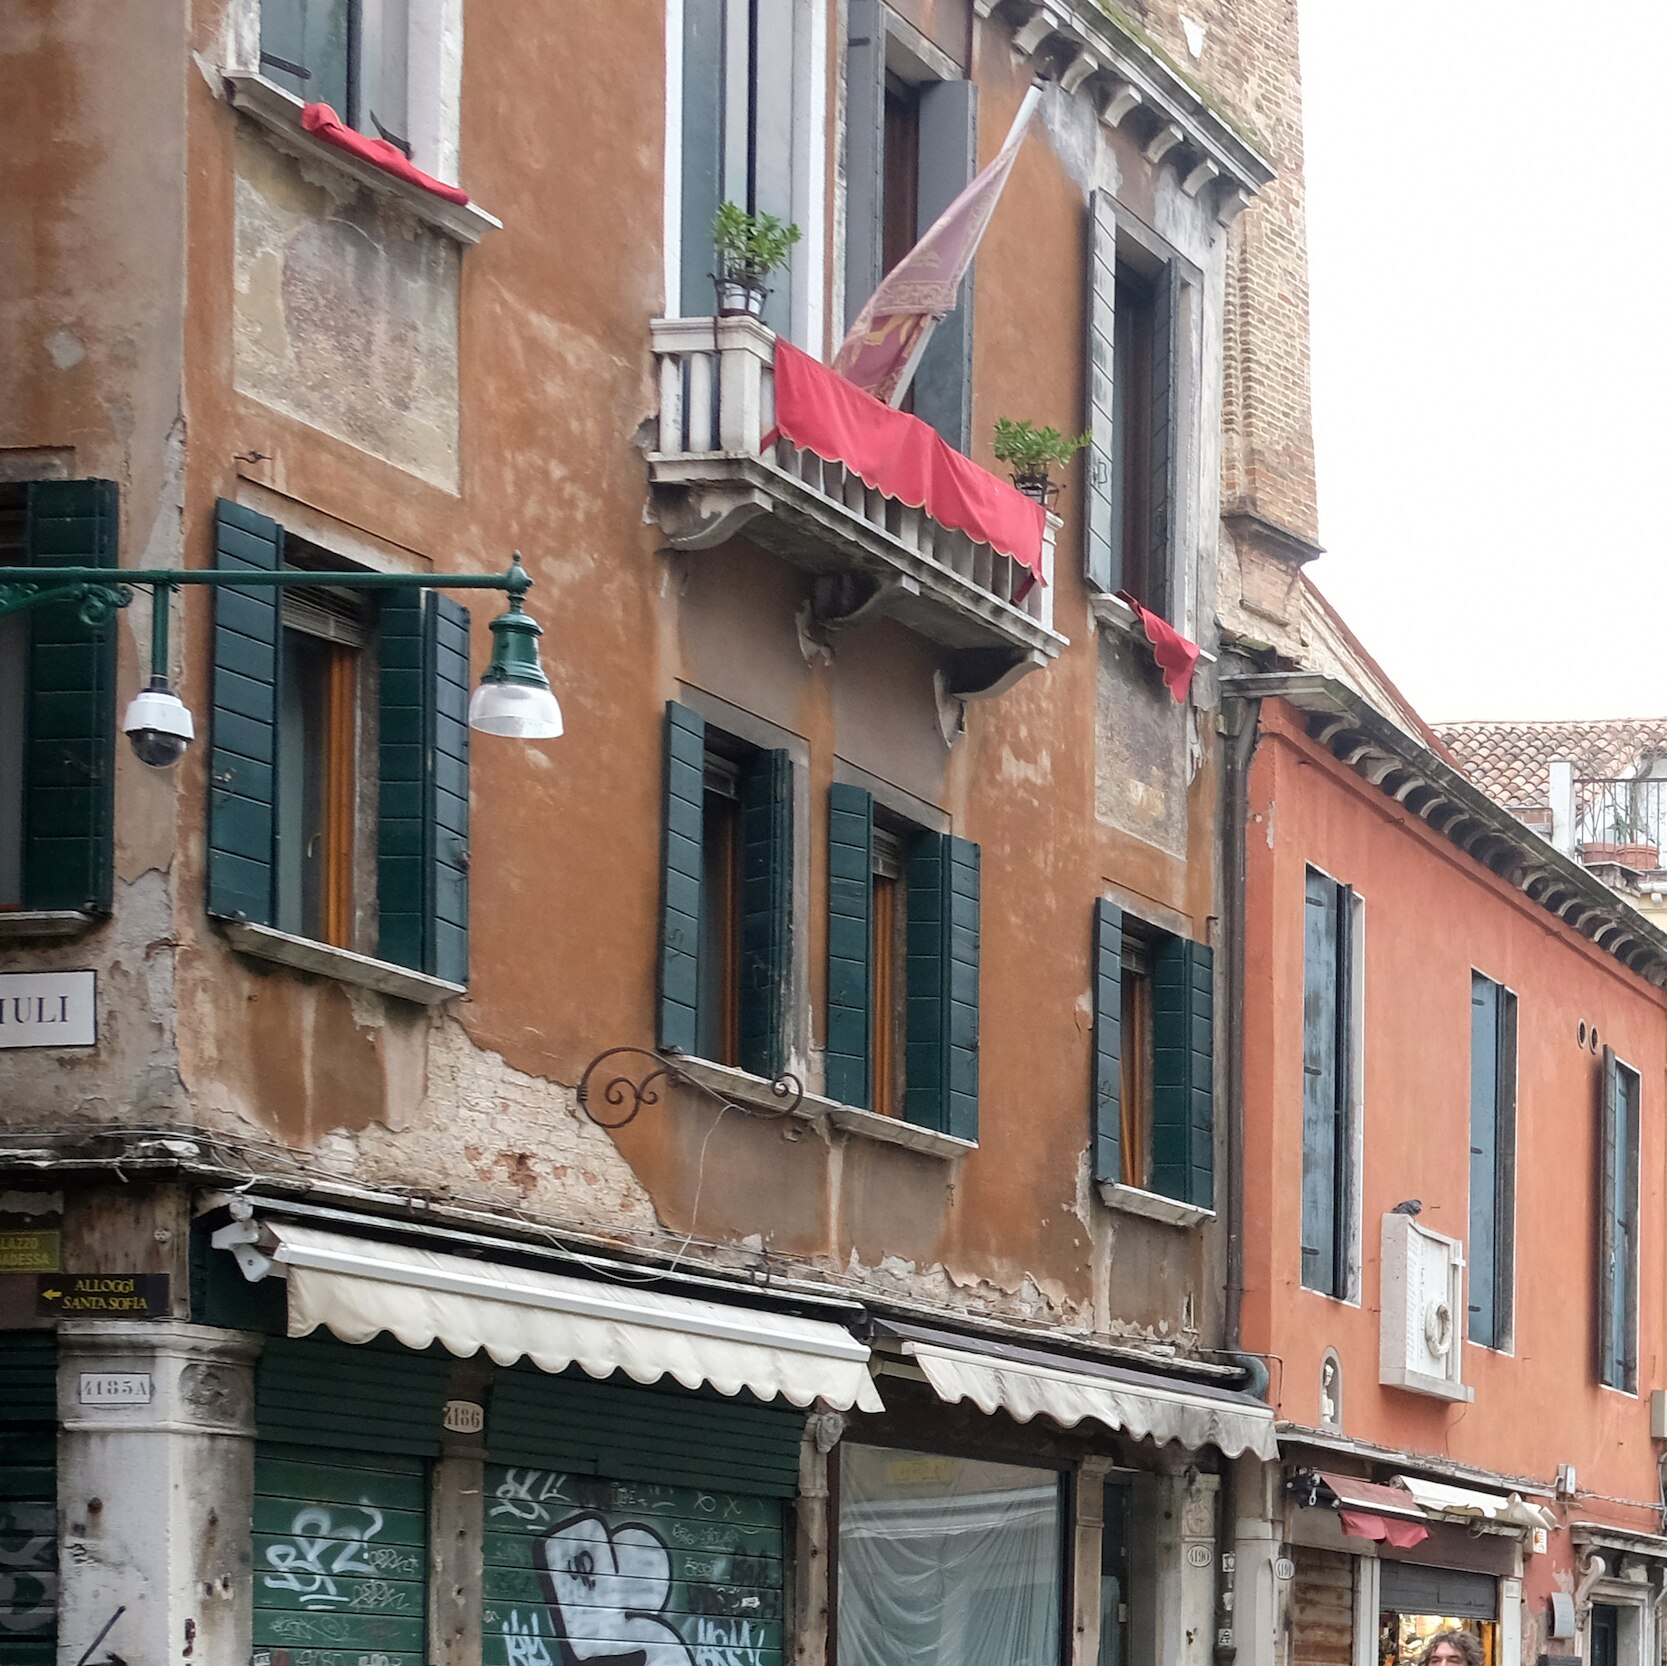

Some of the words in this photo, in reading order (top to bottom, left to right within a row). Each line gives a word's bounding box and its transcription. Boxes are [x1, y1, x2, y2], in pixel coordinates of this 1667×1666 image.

[74, 1279, 135, 1293] ALLOGGI
[62, 1296, 107, 1310] SANTA
[109, 1297, 148, 1311] SOFIA
[83, 1379, 148, 1396] 4185A
